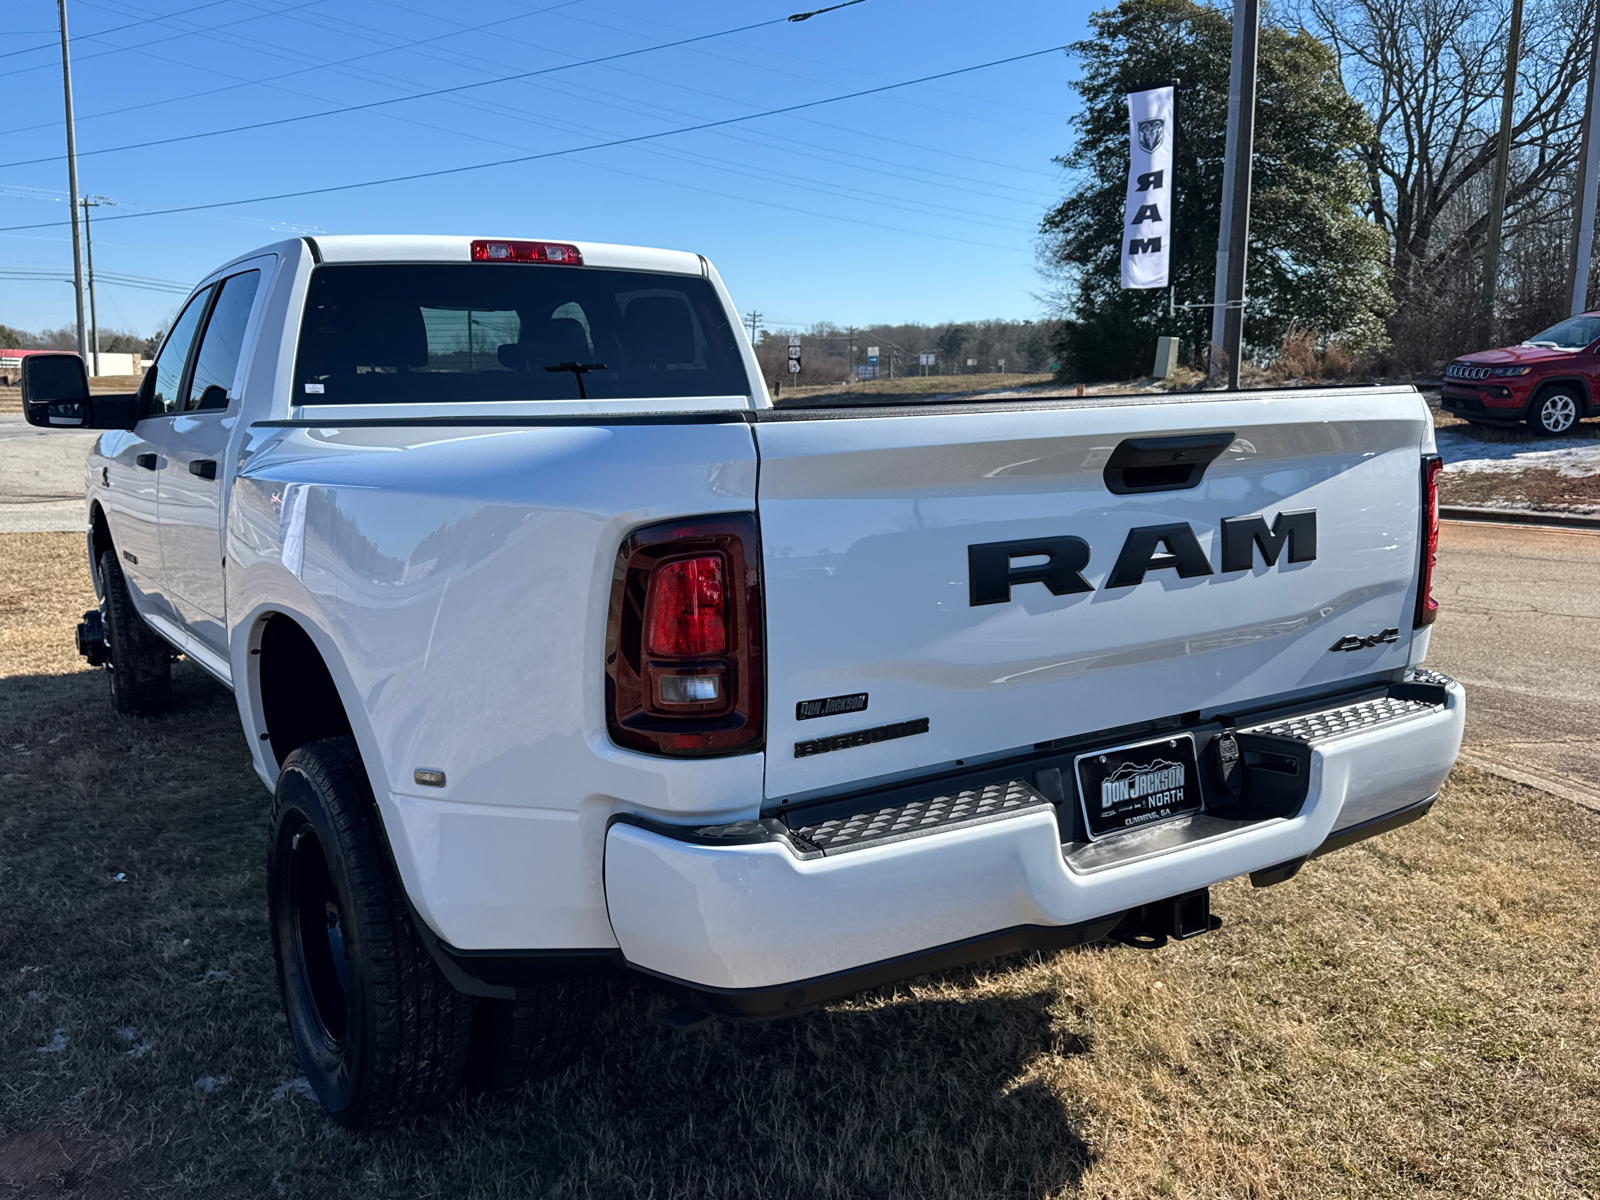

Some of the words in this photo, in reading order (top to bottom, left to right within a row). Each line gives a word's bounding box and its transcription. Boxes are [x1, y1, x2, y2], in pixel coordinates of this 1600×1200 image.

[968, 507, 1317, 607] RAM
[799, 701, 822, 719] DON
[821, 695, 866, 714] JACKSON
[1102, 779, 1130, 809] DON
[1130, 766, 1185, 799] JACKSON
[1148, 788, 1184, 809] NORTH
[1160, 808, 1171, 817] GA
